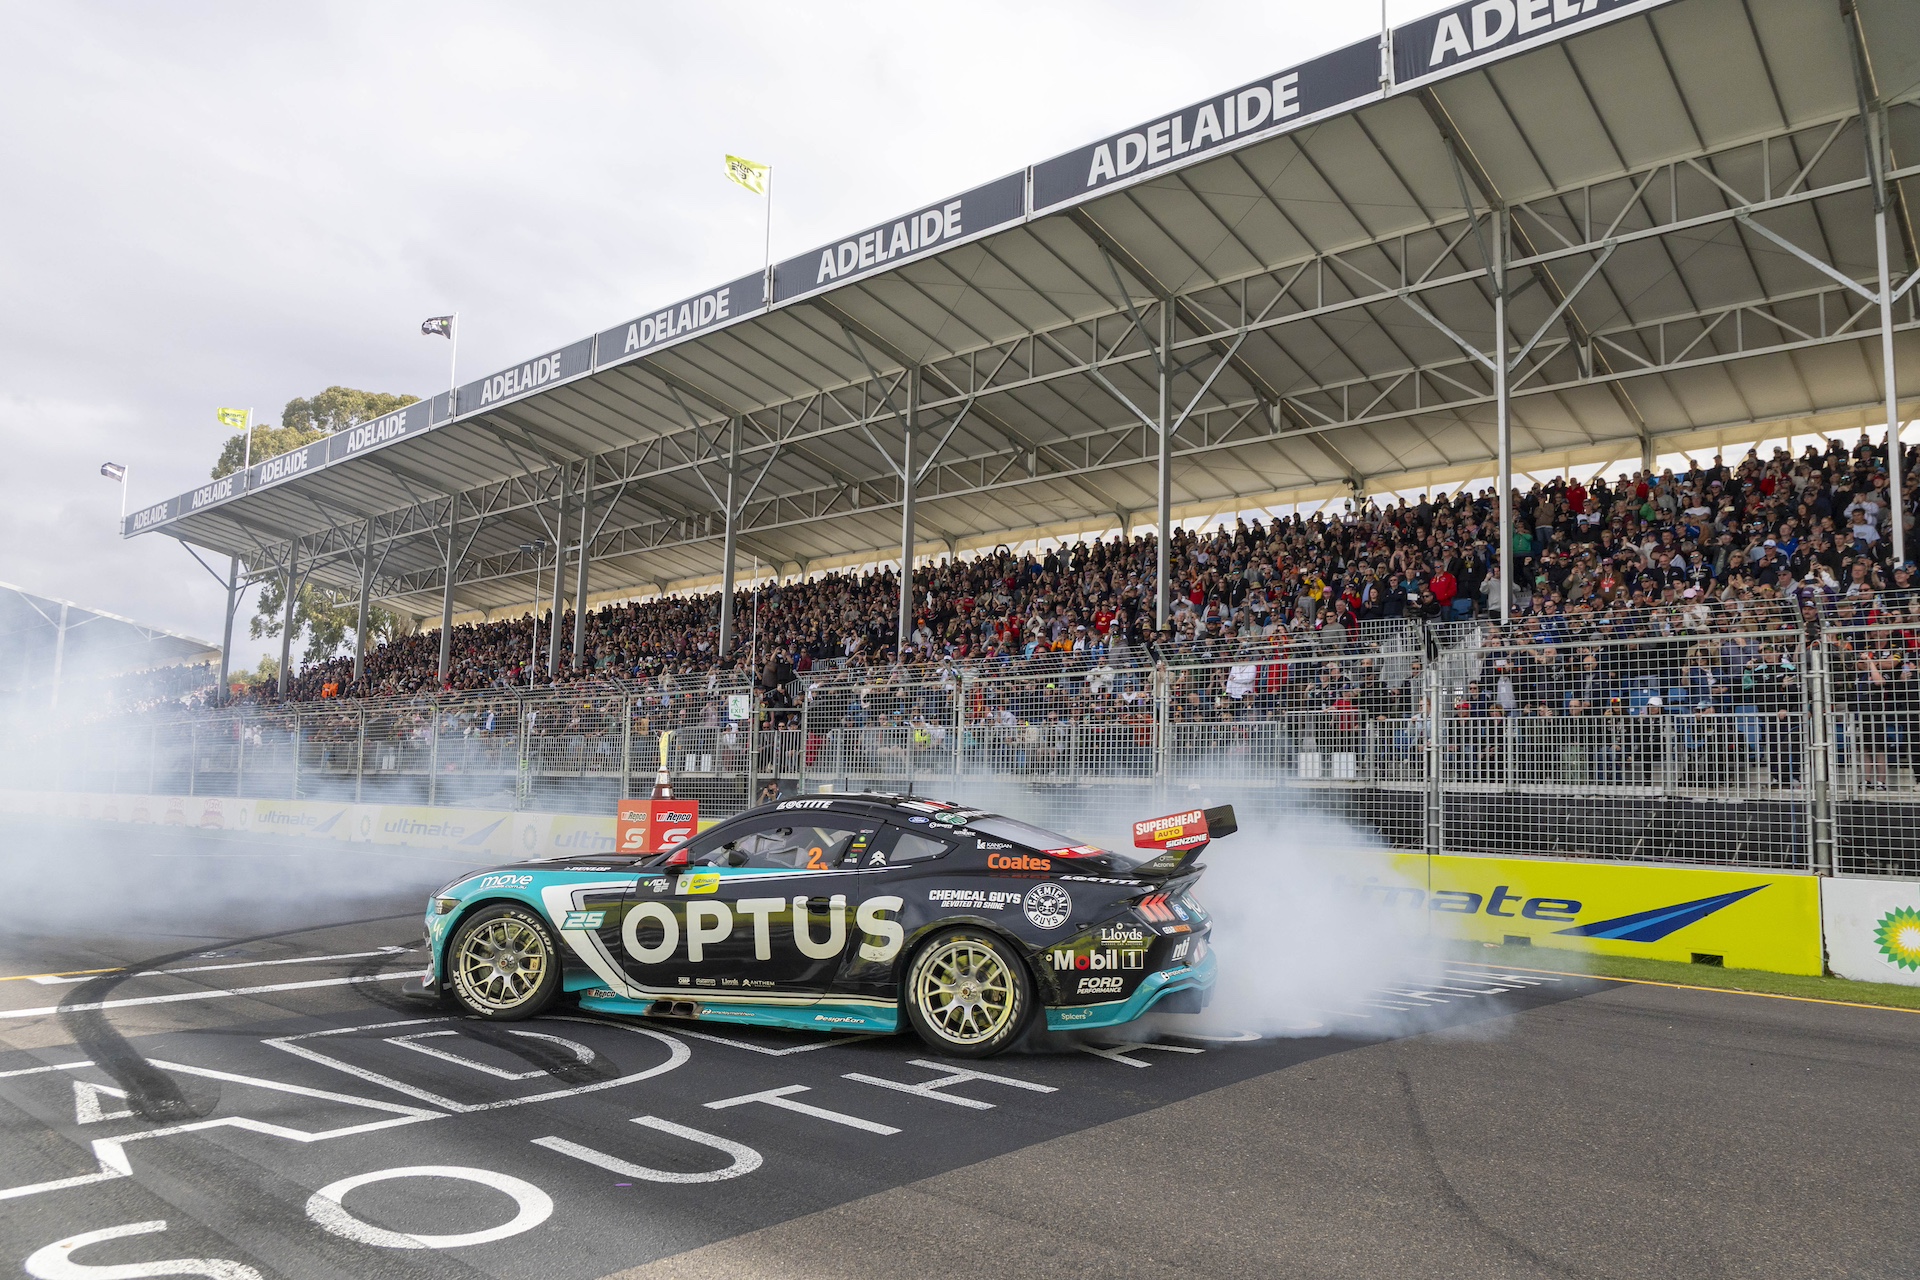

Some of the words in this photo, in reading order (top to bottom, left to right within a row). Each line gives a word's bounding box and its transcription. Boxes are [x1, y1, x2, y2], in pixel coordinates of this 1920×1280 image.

[1086, 70, 1300, 188] ADELAIDE
[817, 200, 962, 284] ADELAIDE
[624, 288, 730, 353] ADELAIDE
[480, 353, 561, 404] ADELAIDE
[346, 411, 406, 454] ADELAIDE
[259, 449, 308, 485] ADELAIDE
[192, 478, 232, 509] ADELAIDE
[133, 503, 168, 530] ADELAIDE
[776, 800, 834, 810] LOCTITE
[258, 810, 317, 826] ultimate
[627, 811, 647, 822] Repco
[667, 811, 692, 823] Repco
[1135, 810, 1202, 836] SUPERCHEAP
[383, 818, 465, 838] ultimate
[1157, 828, 1180, 838] AUTO
[1166, 833, 1207, 848] SIGNZONE
[987, 853, 1051, 871] Coates
[480, 874, 533, 888] move
[1059, 875, 1142, 885] LOCTITE
[928, 890, 987, 902] CHEMICAL
[988, 891, 1021, 905] GUYS
[941, 900, 972, 908] DEVOTED
[983, 902, 1005, 910] SHINE
[1028, 886, 1068, 909] CHEMICAL
[568, 913, 602, 928] 25
[1032, 914, 1060, 926] GUYS
[516, 912, 555, 956] DUNLOP
[621, 894, 905, 965] OPTUS
[1101, 928, 1143, 943] Lloyds
[1054, 949, 1118, 970] Mobil
[453, 970, 469, 998] MAXX
[1078, 977, 1124, 988] FORD
[594, 989, 616, 997] Repco
[465, 997, 495, 1016] SPORT
[1061, 1012, 1087, 1020] Spicers
